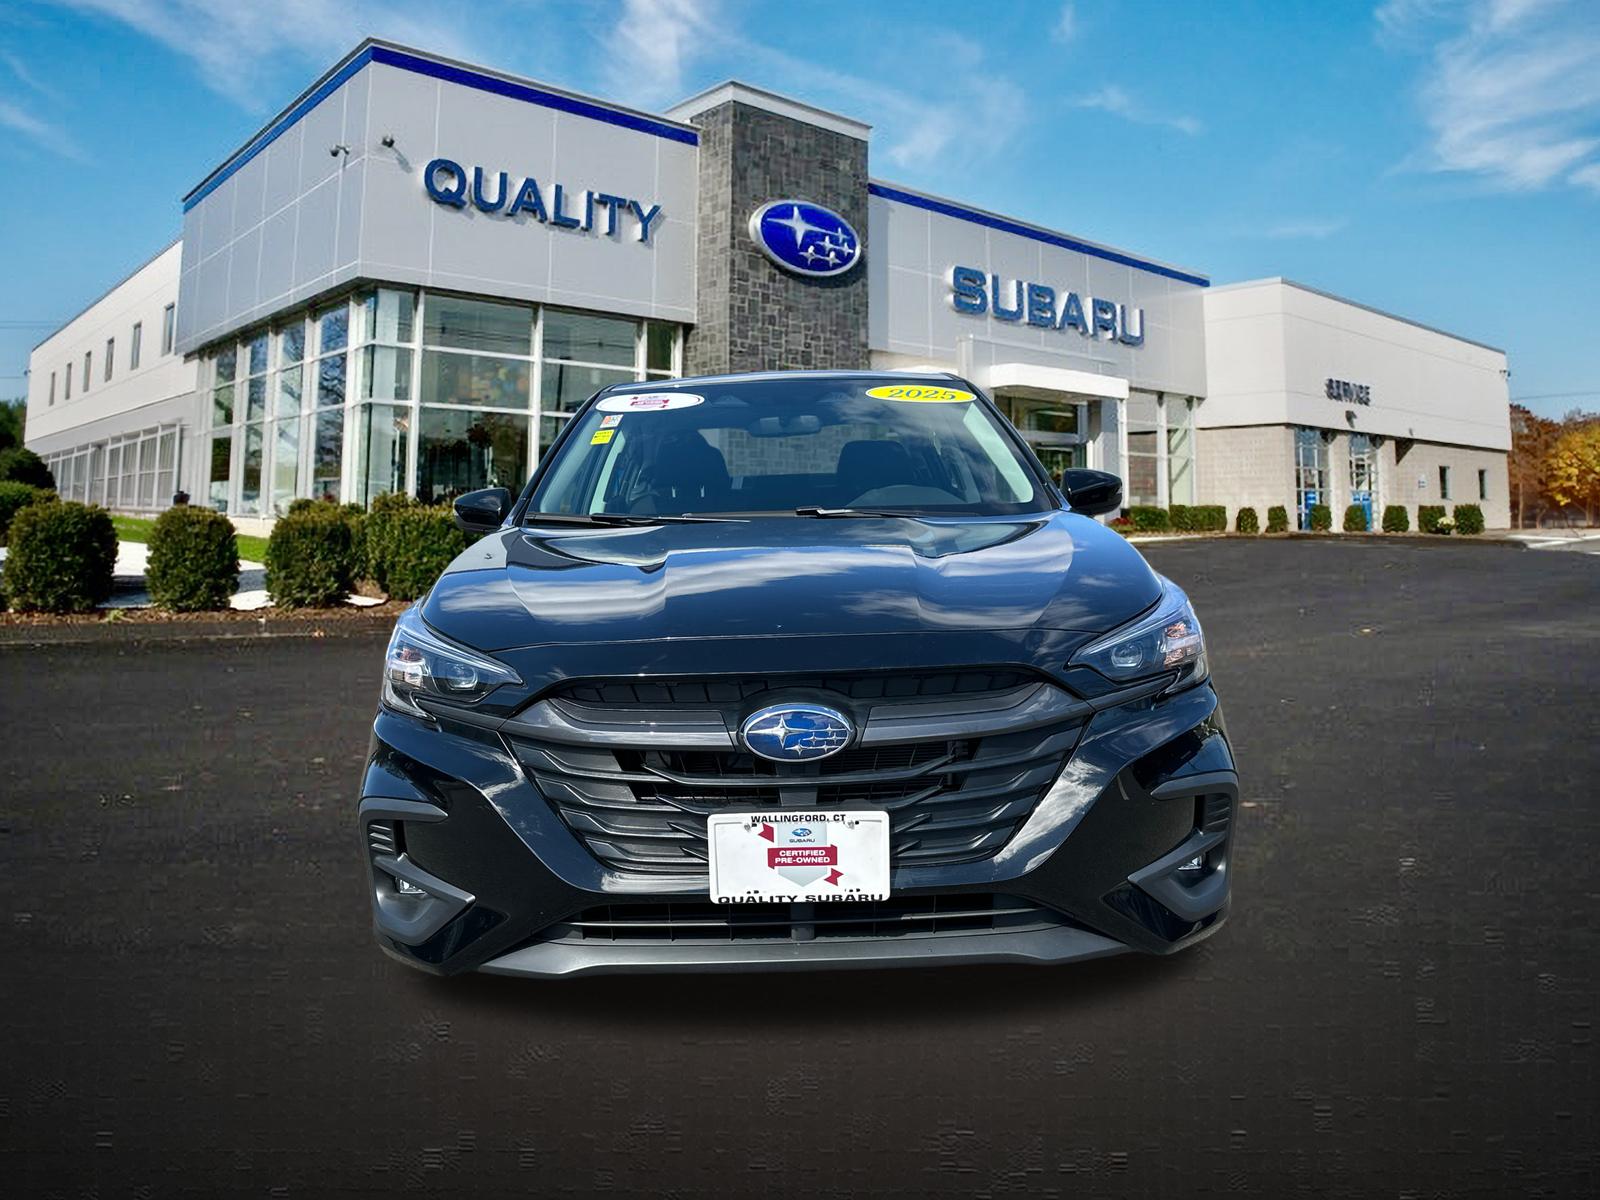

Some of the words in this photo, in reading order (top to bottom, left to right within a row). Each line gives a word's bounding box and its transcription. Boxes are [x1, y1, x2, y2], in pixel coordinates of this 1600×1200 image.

[424, 158, 661, 242] QUALITY
[951, 265, 1145, 346] SUBARU
[888, 388, 956, 401] 2025
[833, 814, 846, 822] CT
[775, 856, 830, 864] PRE-OWNED
[718, 895, 798, 904] QUALITY
[805, 894, 883, 902] SUBARU
